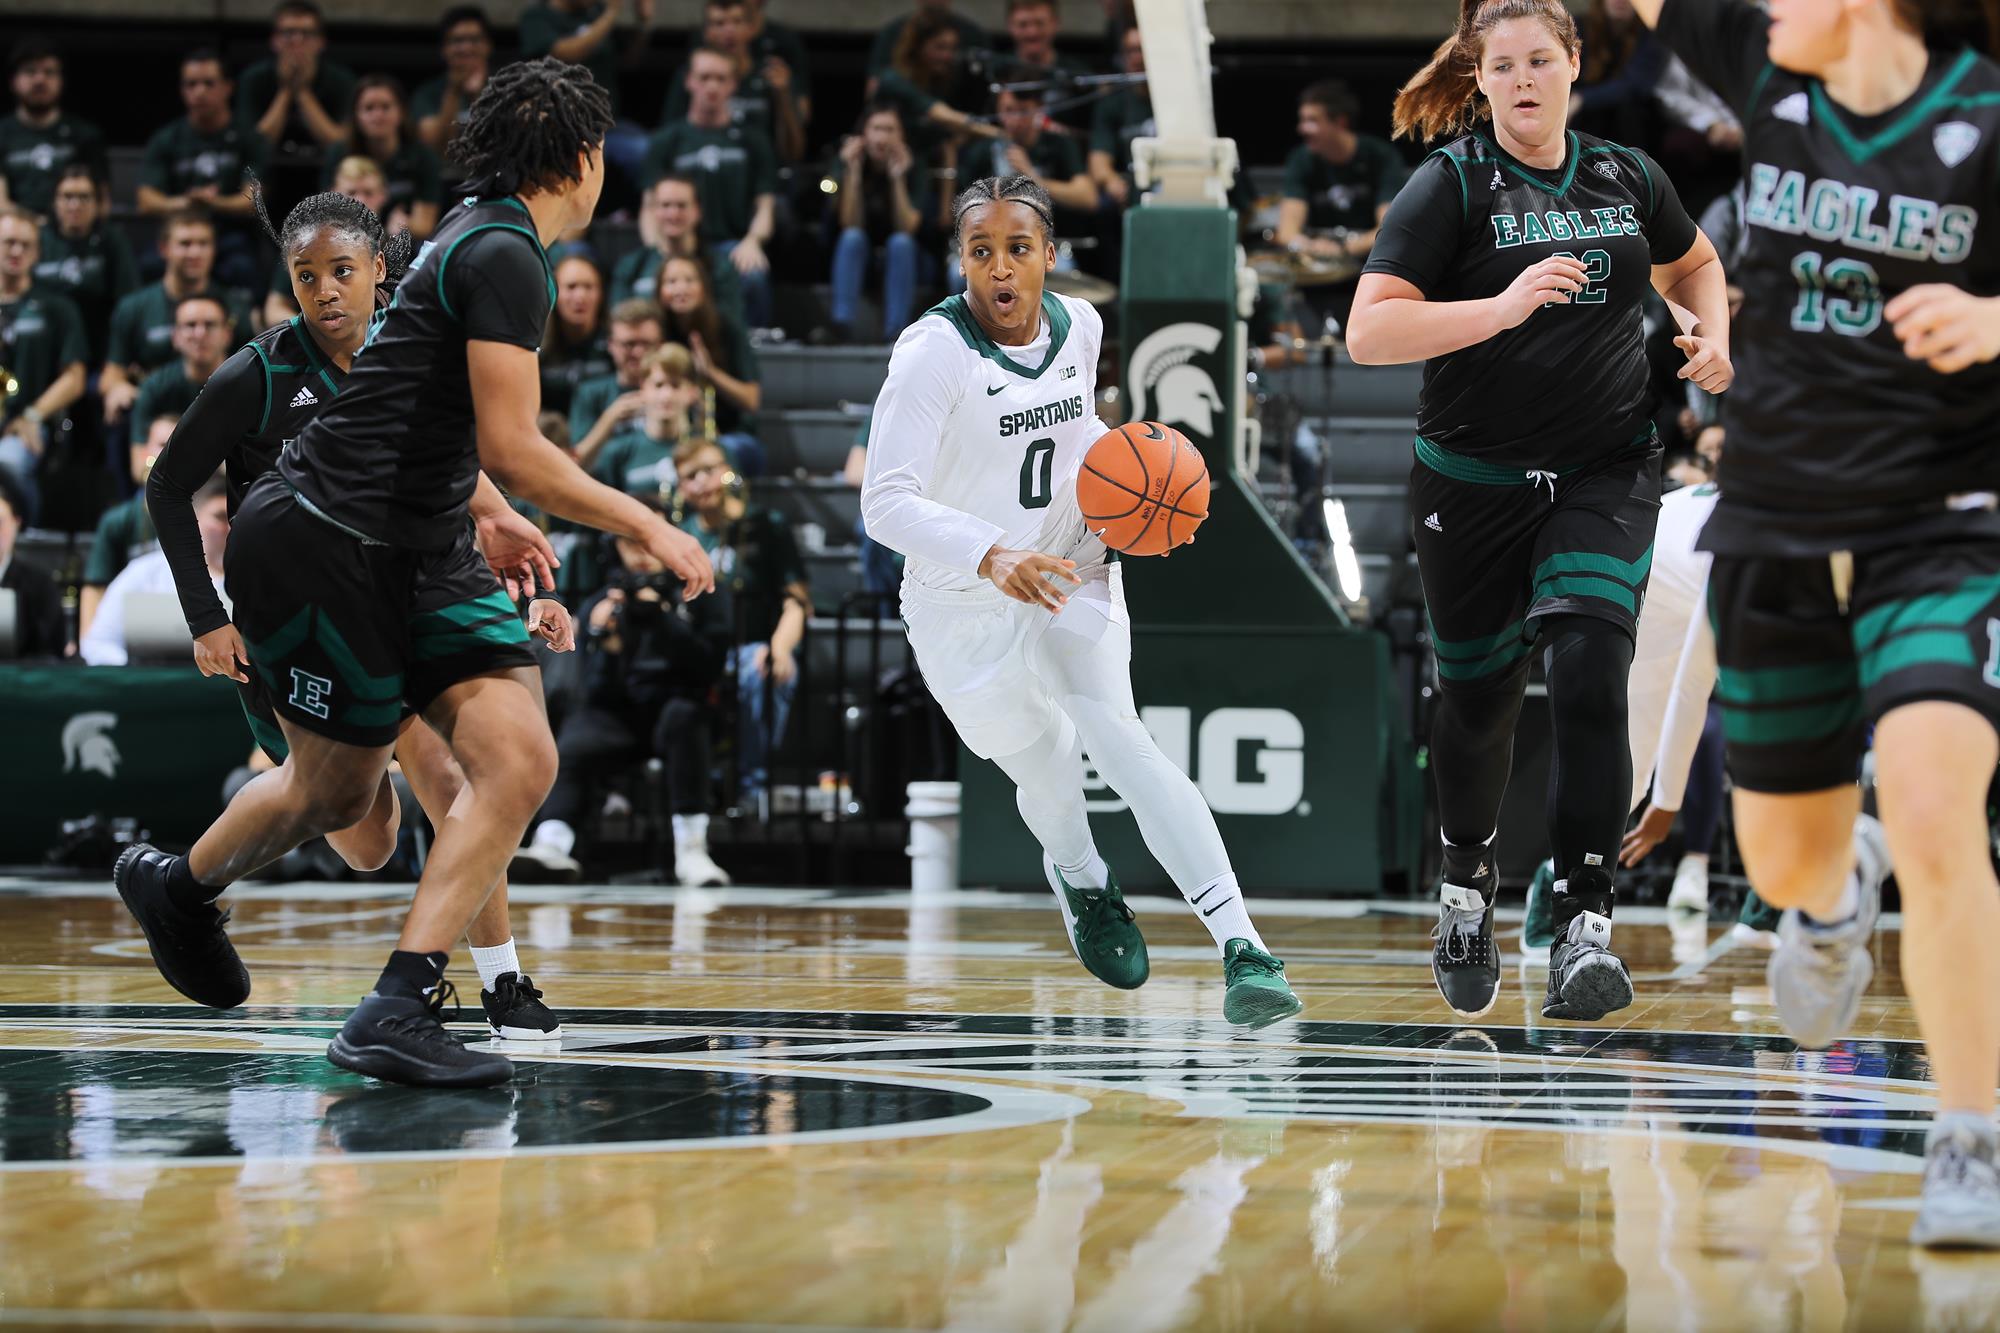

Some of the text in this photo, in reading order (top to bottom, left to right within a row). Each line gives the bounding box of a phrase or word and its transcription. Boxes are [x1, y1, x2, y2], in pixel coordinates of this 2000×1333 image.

[1491, 205, 1639, 249] EAGLES
[1746, 162, 1978, 264] EAGLES
[1545, 248, 1611, 308] 2
[1790, 251, 1884, 337] 13
[289, 397, 319, 408] adidas
[999, 395, 1083, 437] SPARTANS
[1019, 437, 1056, 510] 0
[289, 666, 332, 720] E
